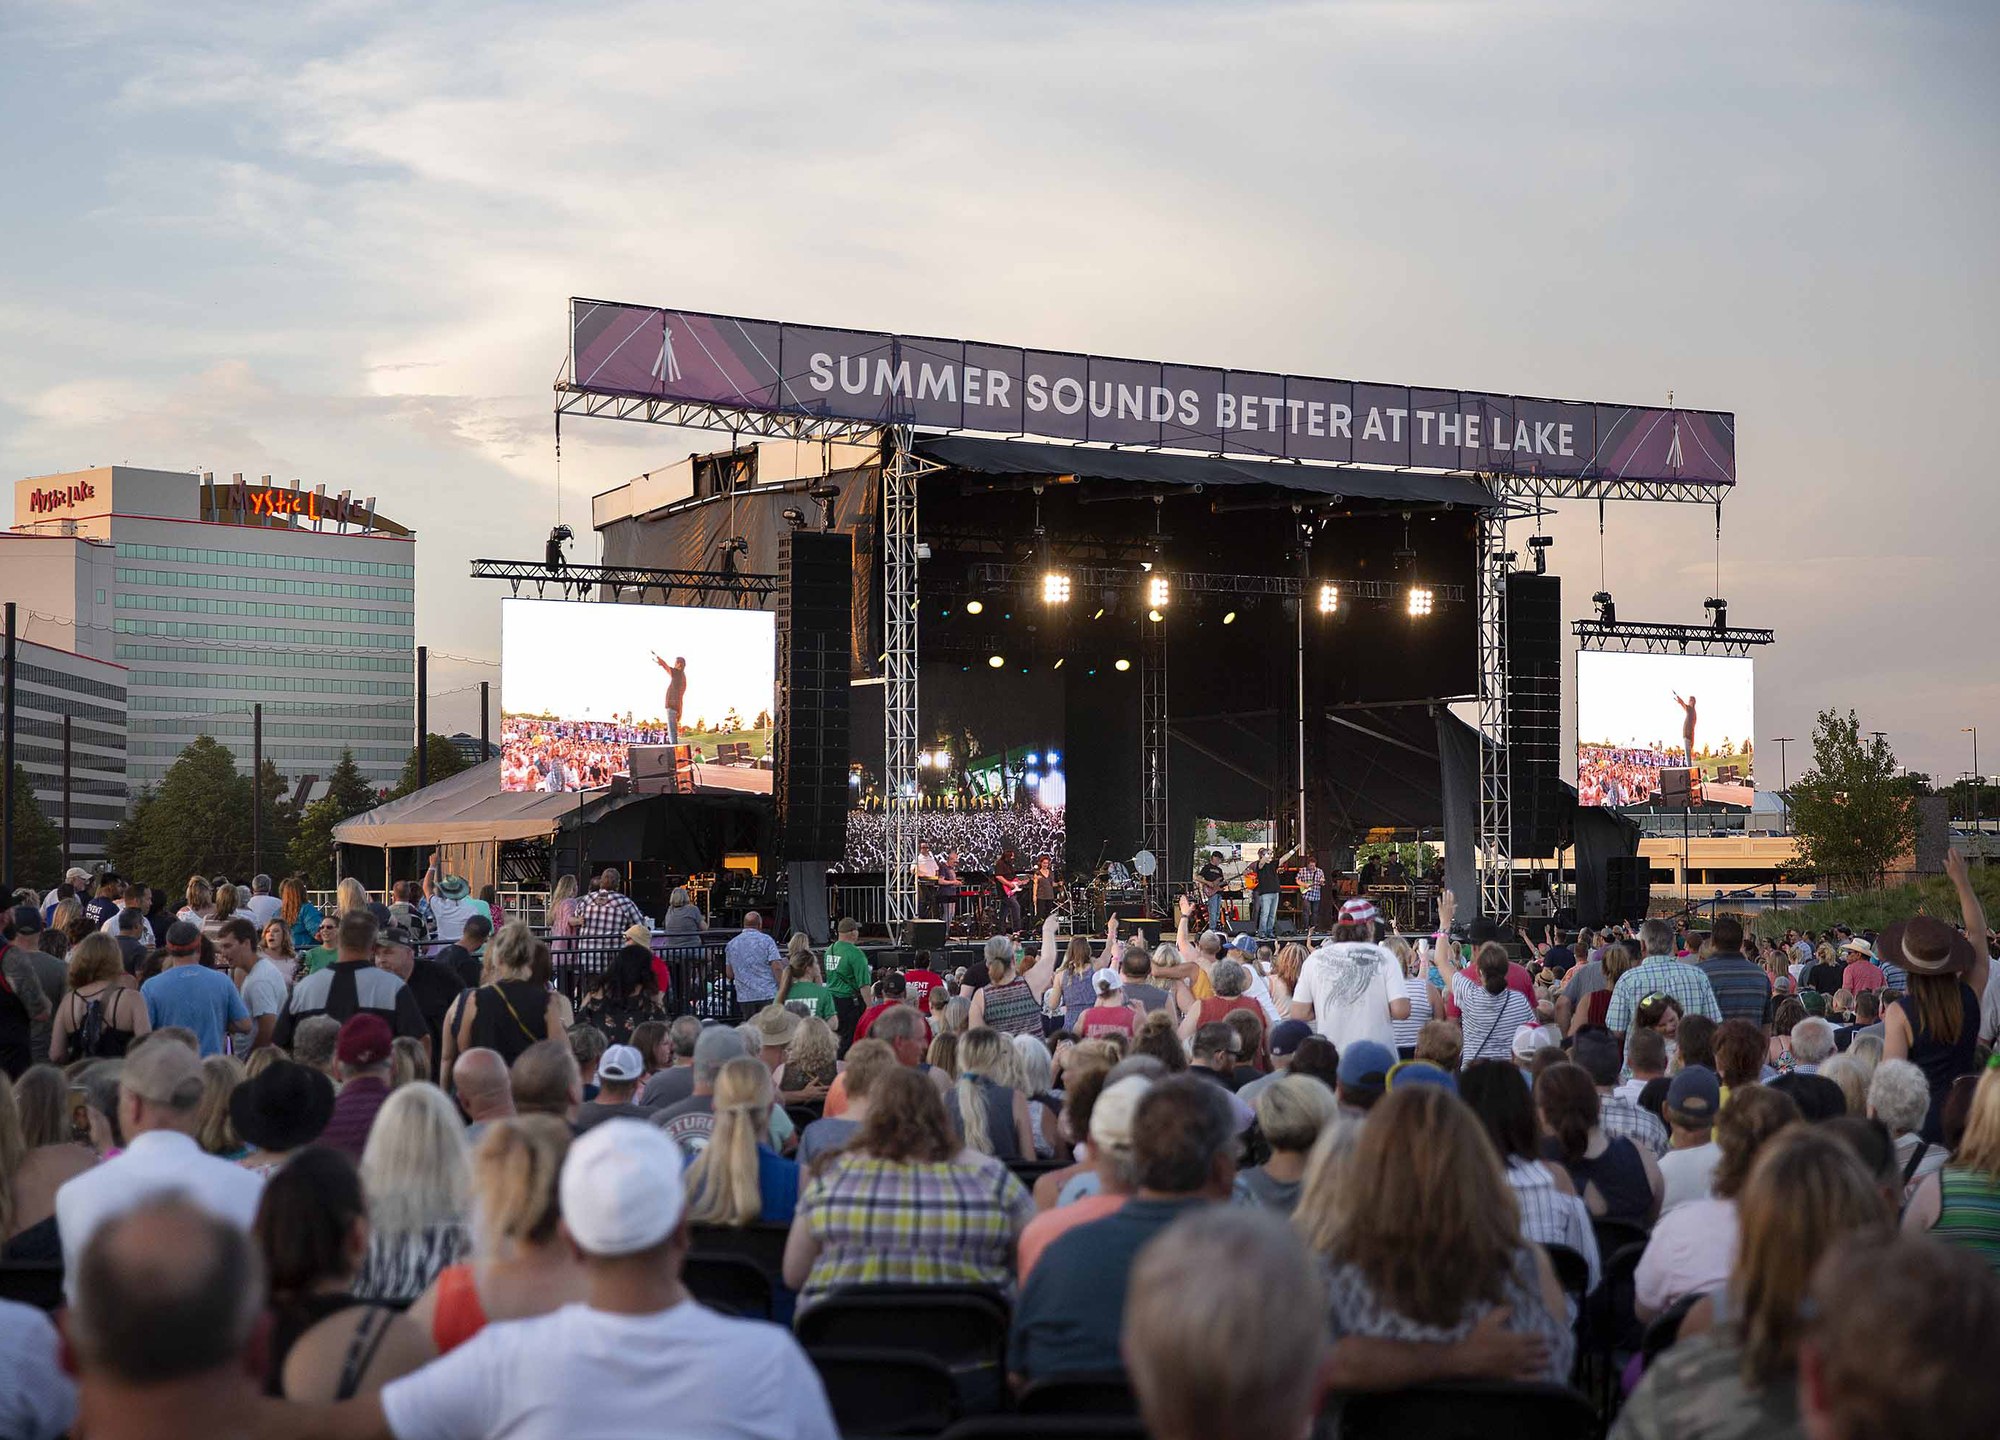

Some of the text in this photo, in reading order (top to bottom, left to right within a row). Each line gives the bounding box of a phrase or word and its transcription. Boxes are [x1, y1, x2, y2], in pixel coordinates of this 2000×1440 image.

[810, 353, 1574, 457] SUMMER SOUNDS BETTER AT THE LAKE
